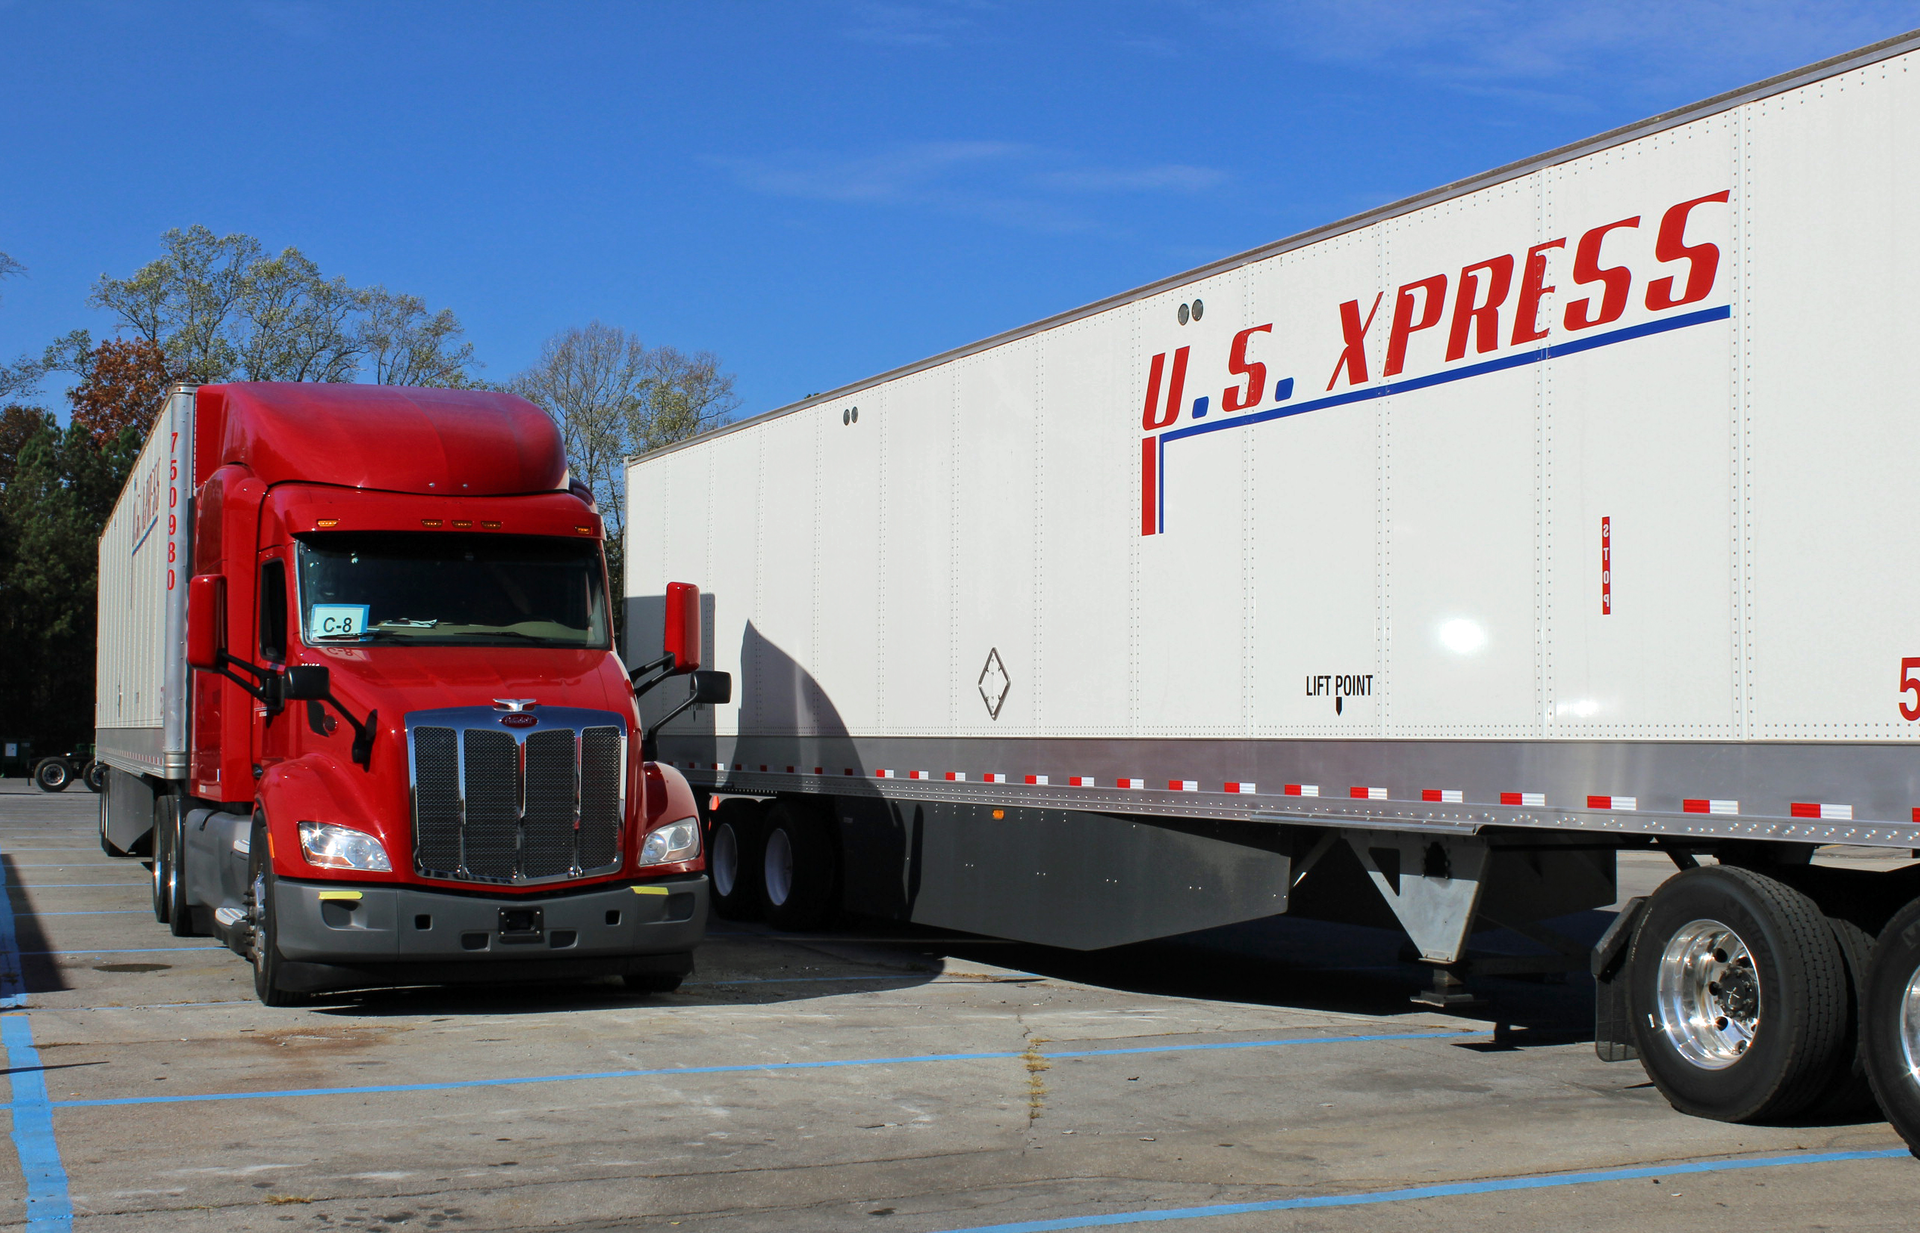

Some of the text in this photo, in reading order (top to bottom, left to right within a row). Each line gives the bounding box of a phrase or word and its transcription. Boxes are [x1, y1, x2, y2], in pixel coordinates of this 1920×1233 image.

[1142, 189, 1731, 431] U.S. XPRESS
[167, 432, 179, 591] 750980
[323, 617, 352, 633] C-8
[1306, 674, 1374, 697] LIFT POINT
[1898, 656, 1920, 722] 5
